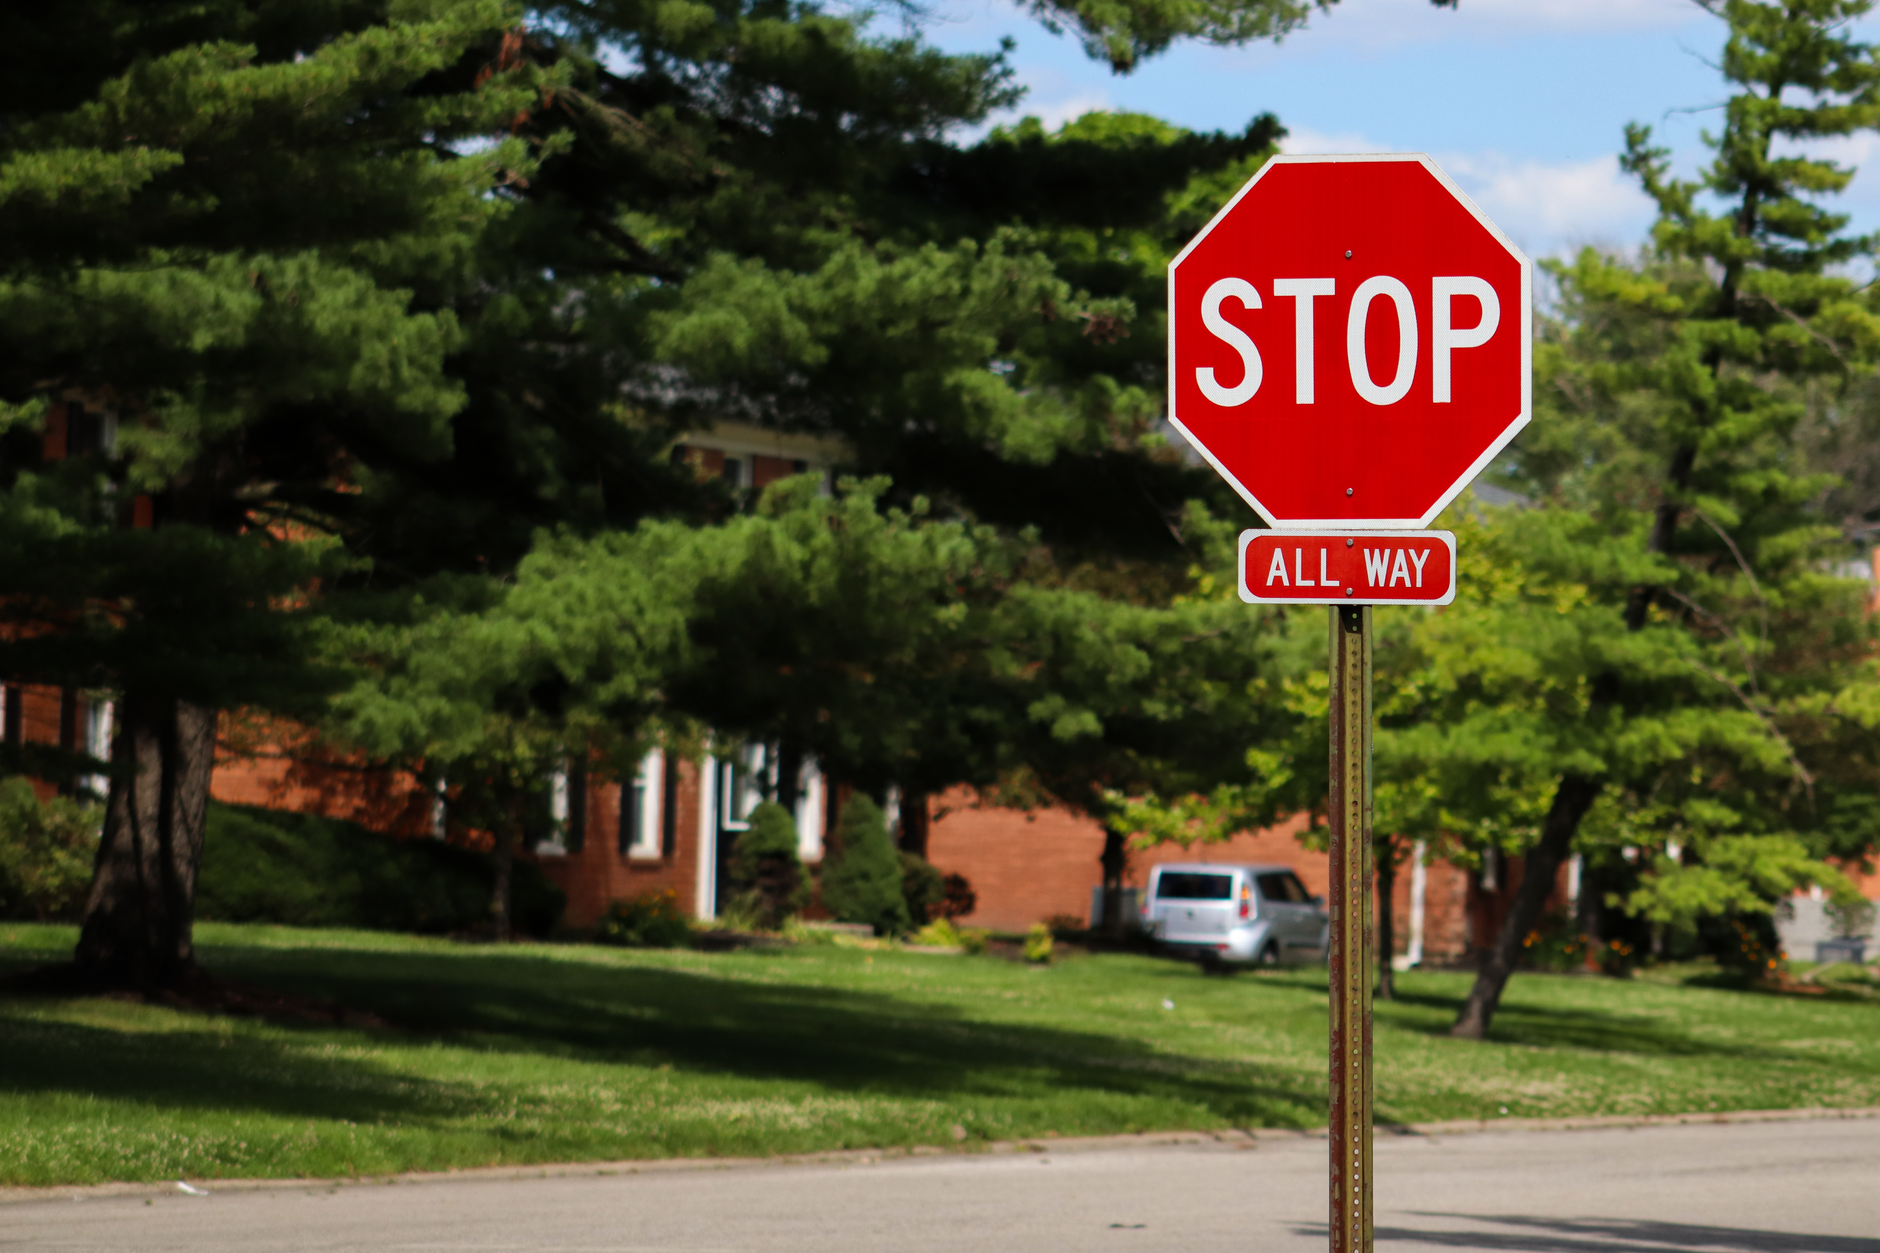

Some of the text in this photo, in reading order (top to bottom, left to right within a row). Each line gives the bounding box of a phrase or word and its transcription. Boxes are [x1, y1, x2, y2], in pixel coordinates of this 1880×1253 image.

[1195, 275, 1501, 407] STOP
[1265, 547, 1431, 588] ALL WAY
